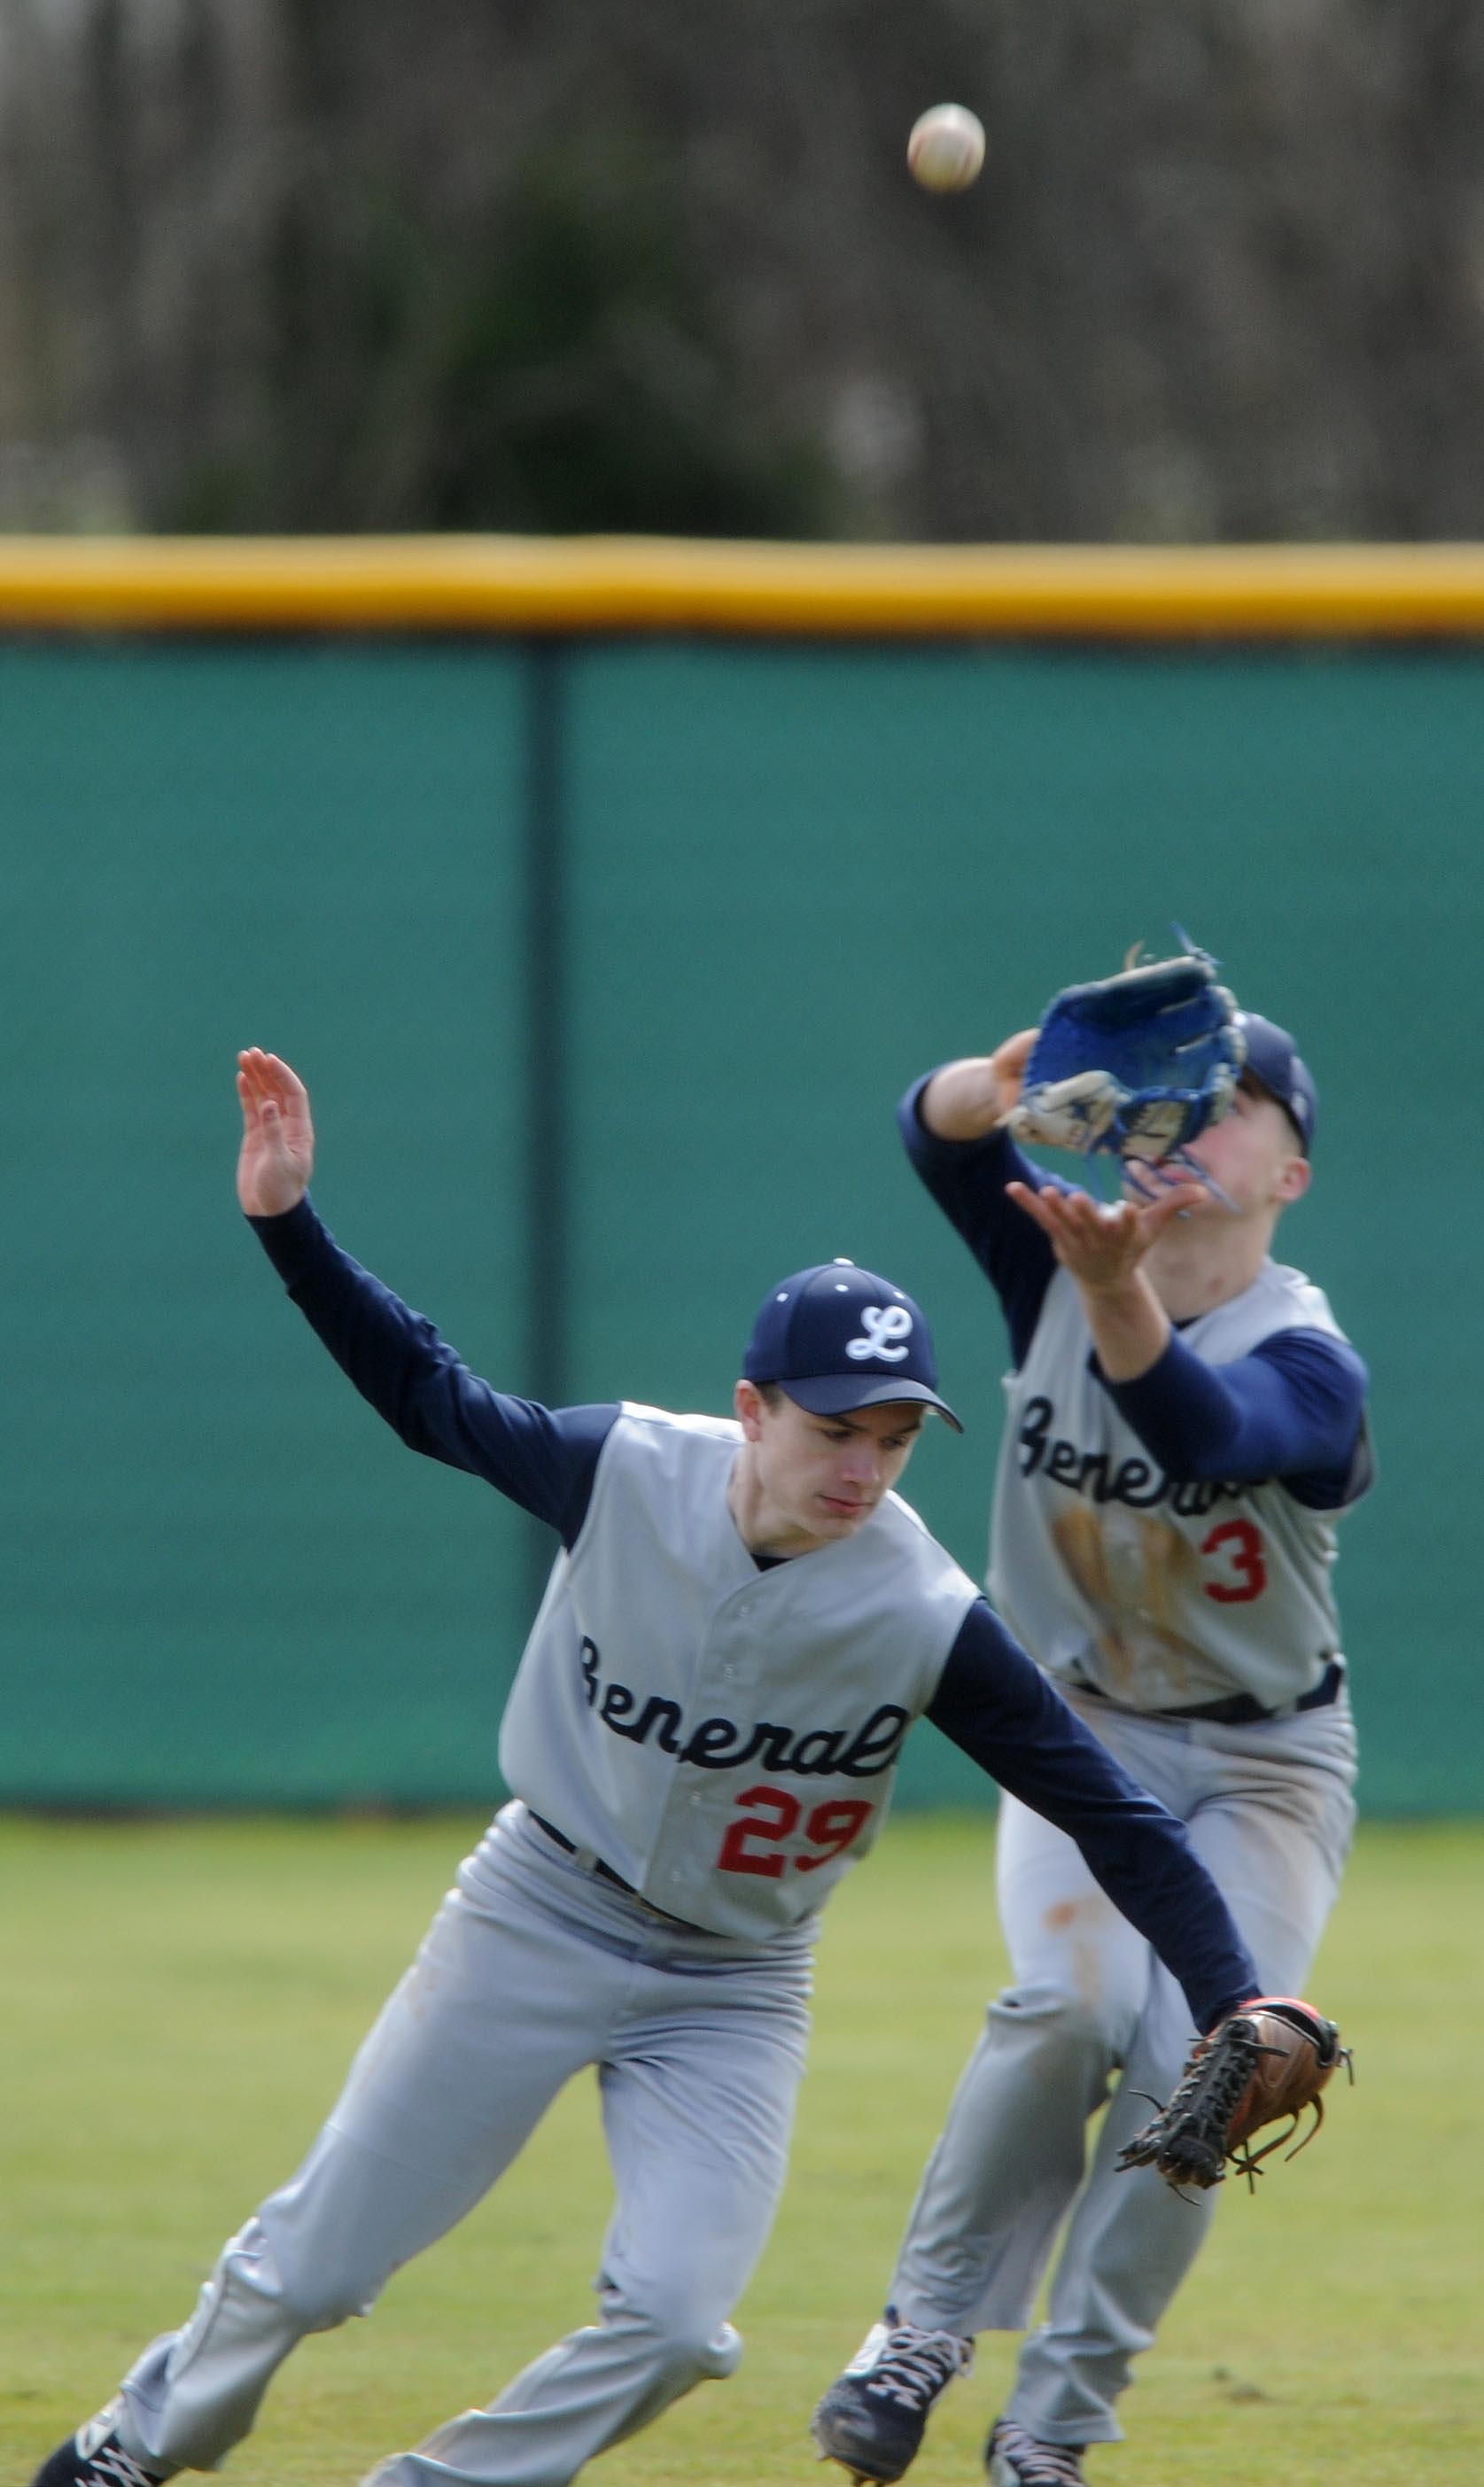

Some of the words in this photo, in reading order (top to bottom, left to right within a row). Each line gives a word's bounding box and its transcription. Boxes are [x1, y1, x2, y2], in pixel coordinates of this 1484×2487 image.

[845, 1305, 913, 1362] L
[1201, 1519, 1267, 1604] 3
[717, 1785, 874, 1878] 29
